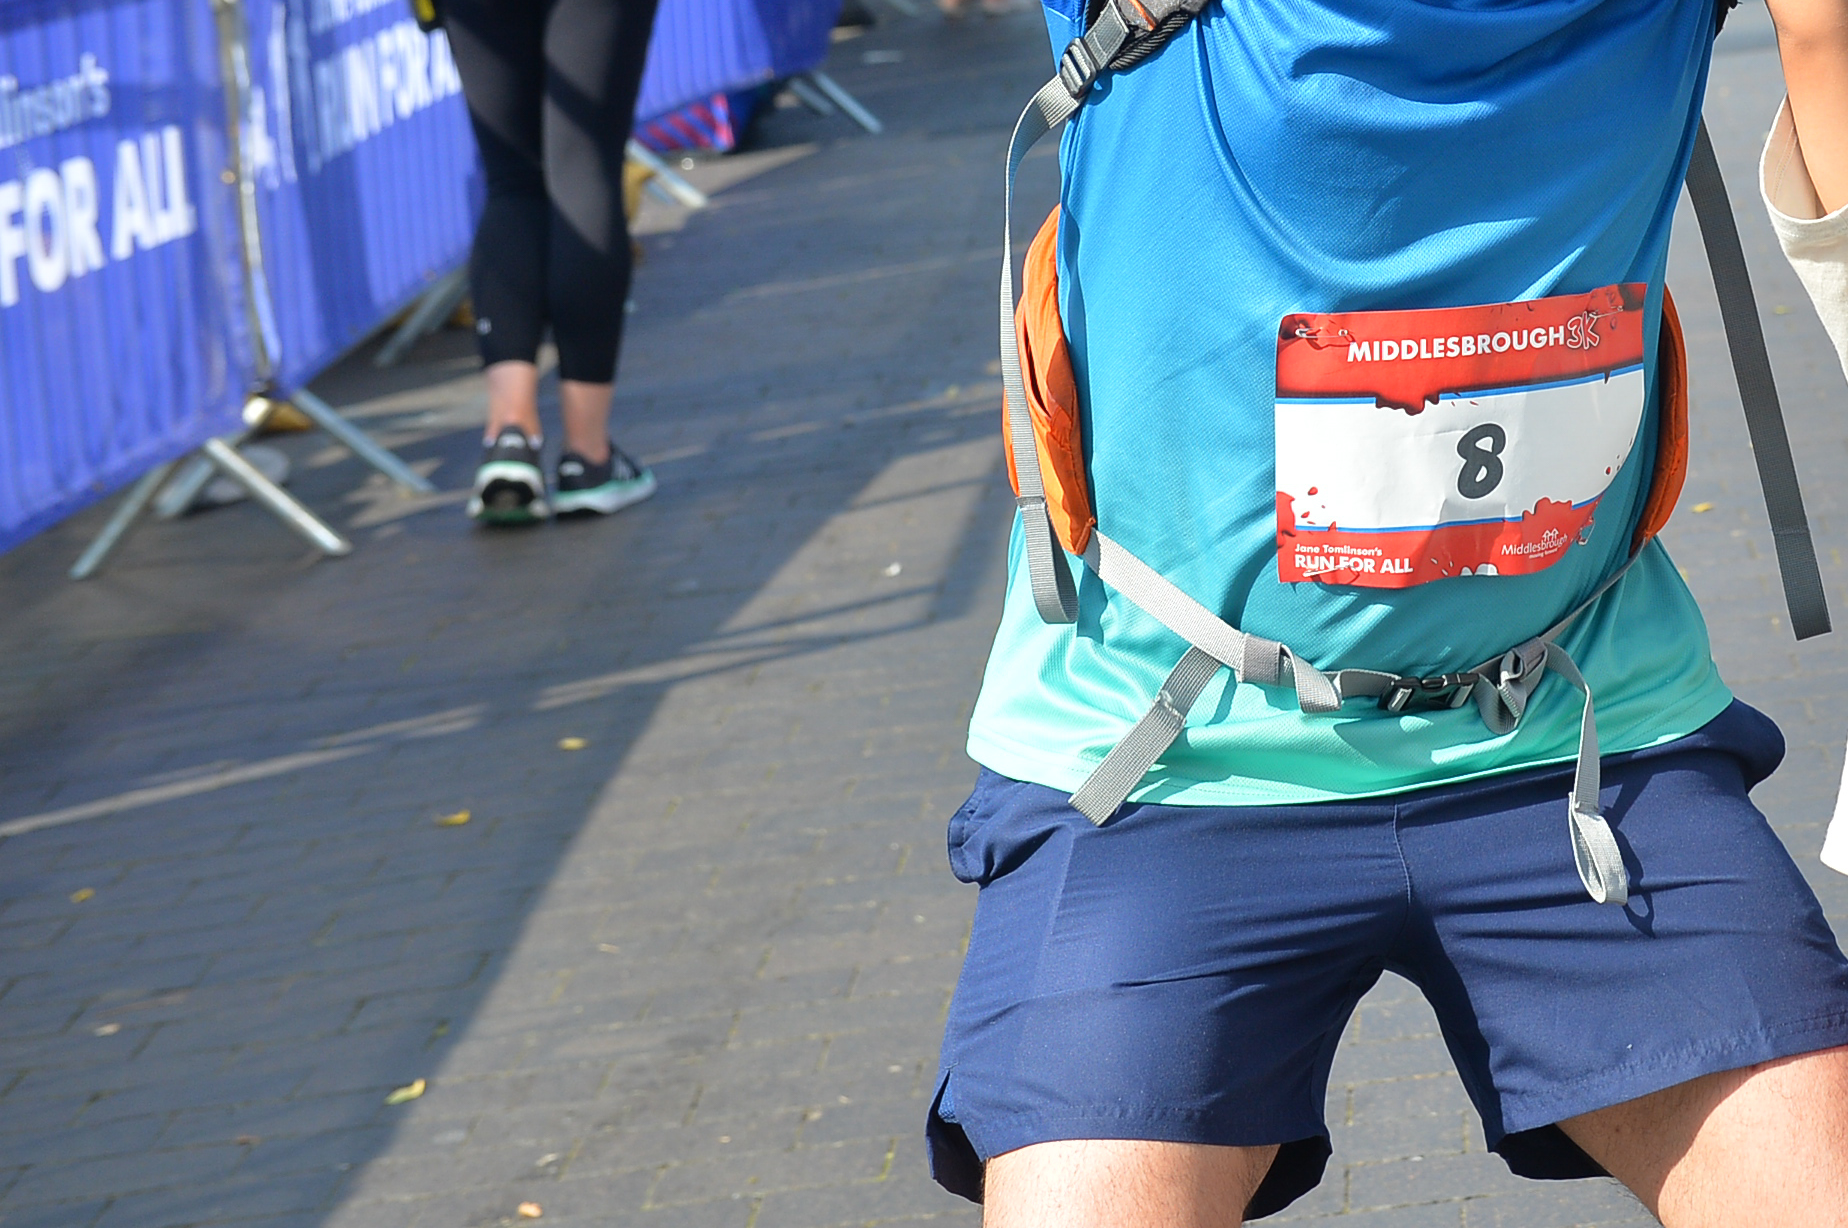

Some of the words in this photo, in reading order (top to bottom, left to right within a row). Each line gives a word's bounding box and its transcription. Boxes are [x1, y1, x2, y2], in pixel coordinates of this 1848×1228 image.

[377, 20, 432, 127] FOR
[0, 154, 108, 308] FOR
[111, 124, 199, 262] ALL
[1347, 325, 1564, 362] MIDDLESBROUGH
[1566, 311, 1600, 350] 3K
[1457, 423, 1506, 499] 8
[1294, 554, 1335, 571] RUN
[1338, 555, 1376, 573] FOR
[1379, 557, 1414, 574] ALL
[1295, 543, 1320, 554] Jane
[1322, 544, 1383, 557] Tomlinson's
[1501, 533, 1568, 555] Middlesbrough
